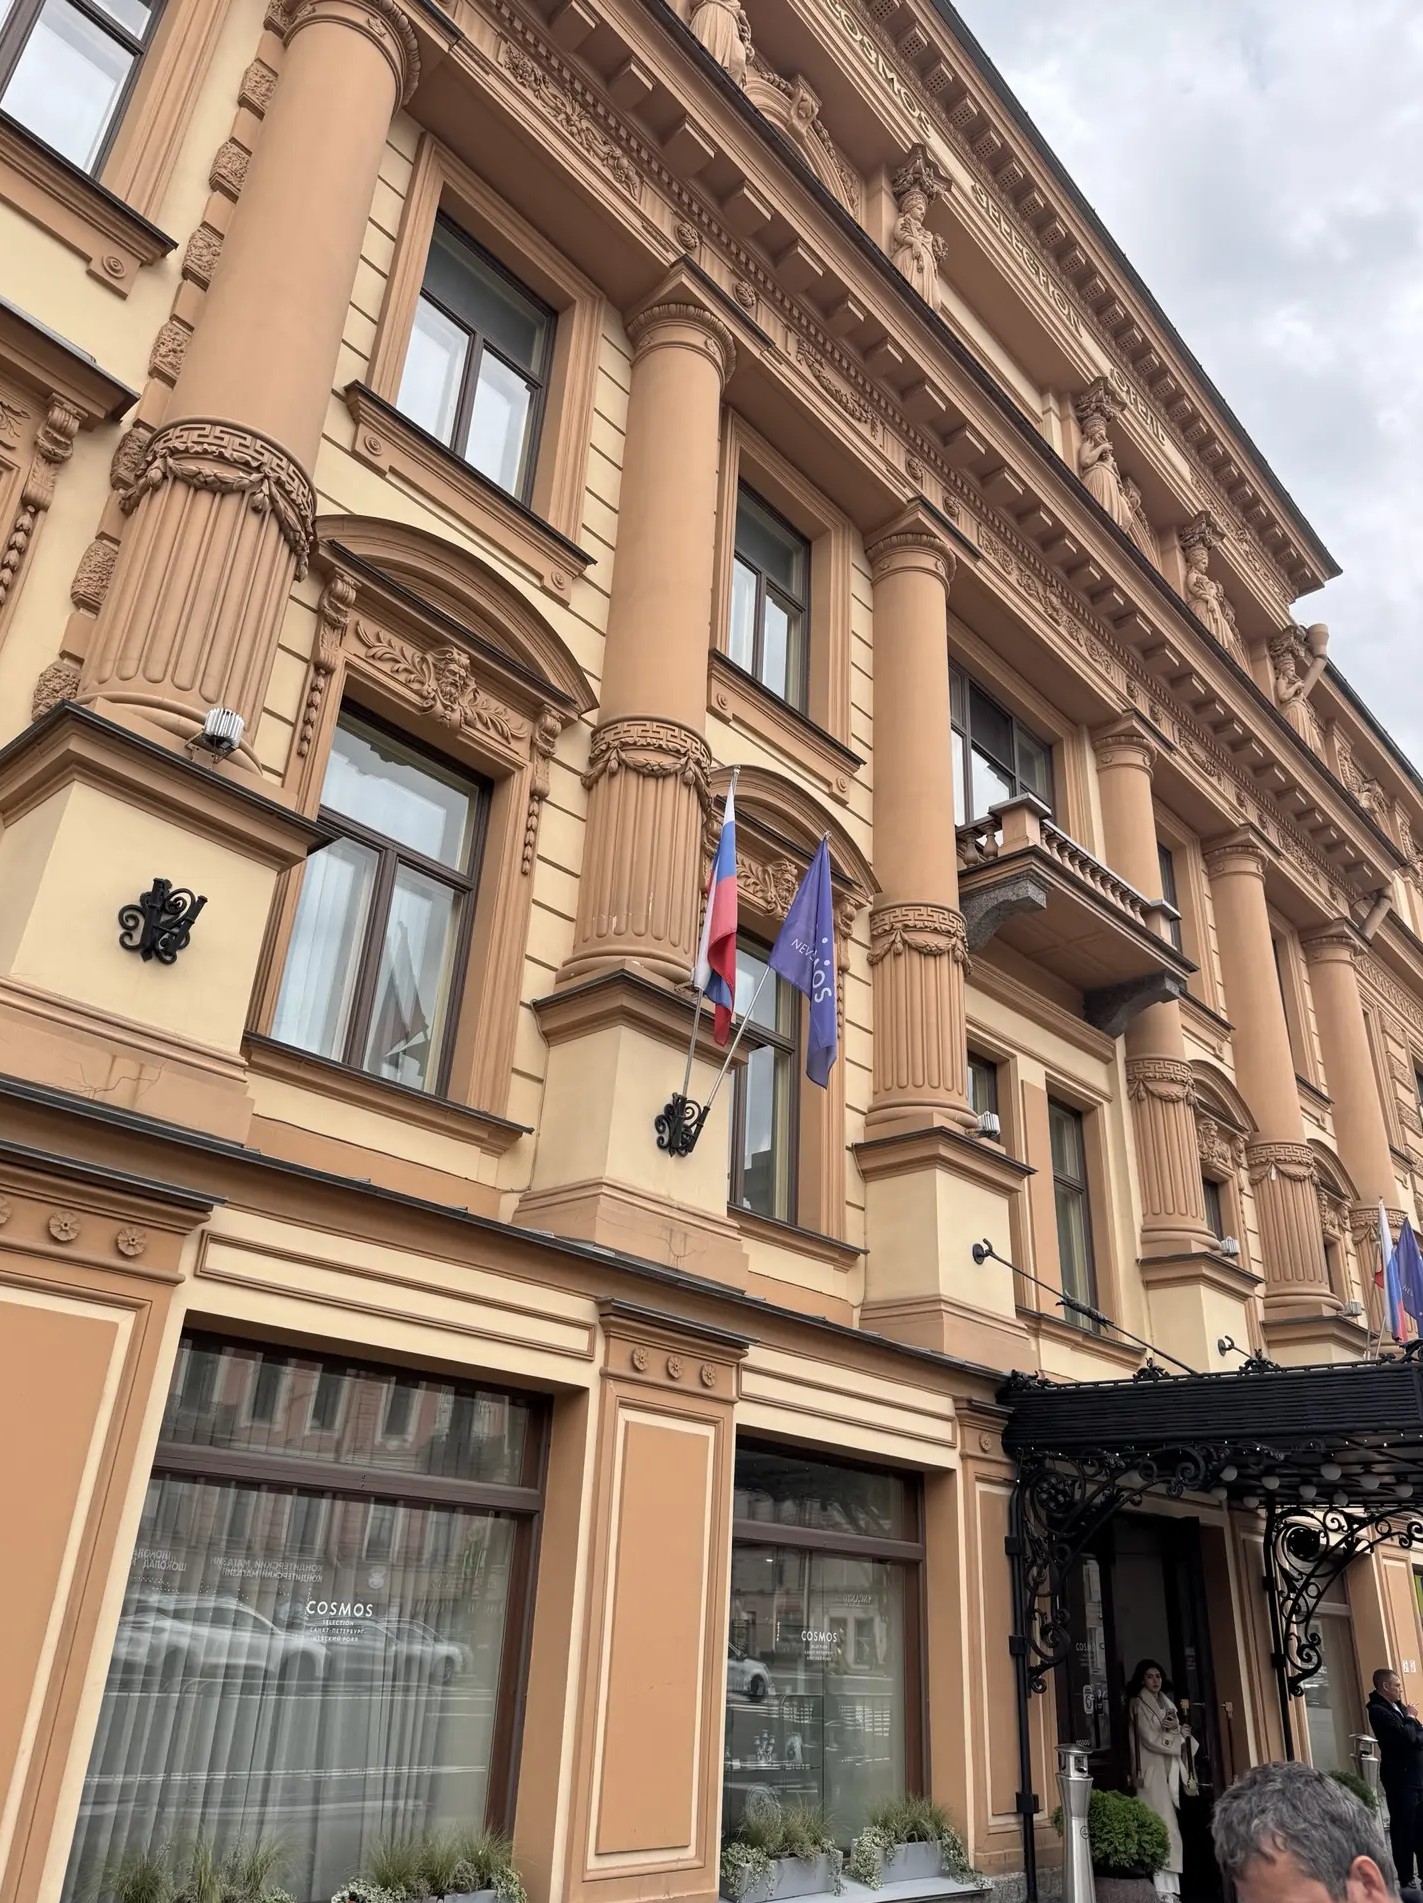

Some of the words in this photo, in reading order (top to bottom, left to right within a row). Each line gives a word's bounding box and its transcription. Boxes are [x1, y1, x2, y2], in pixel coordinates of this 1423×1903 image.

[970, 181, 1084, 339] SELECTION
[306, 1600, 373, 1617] COSMOS
[801, 1630, 838, 1643] COSMOS
